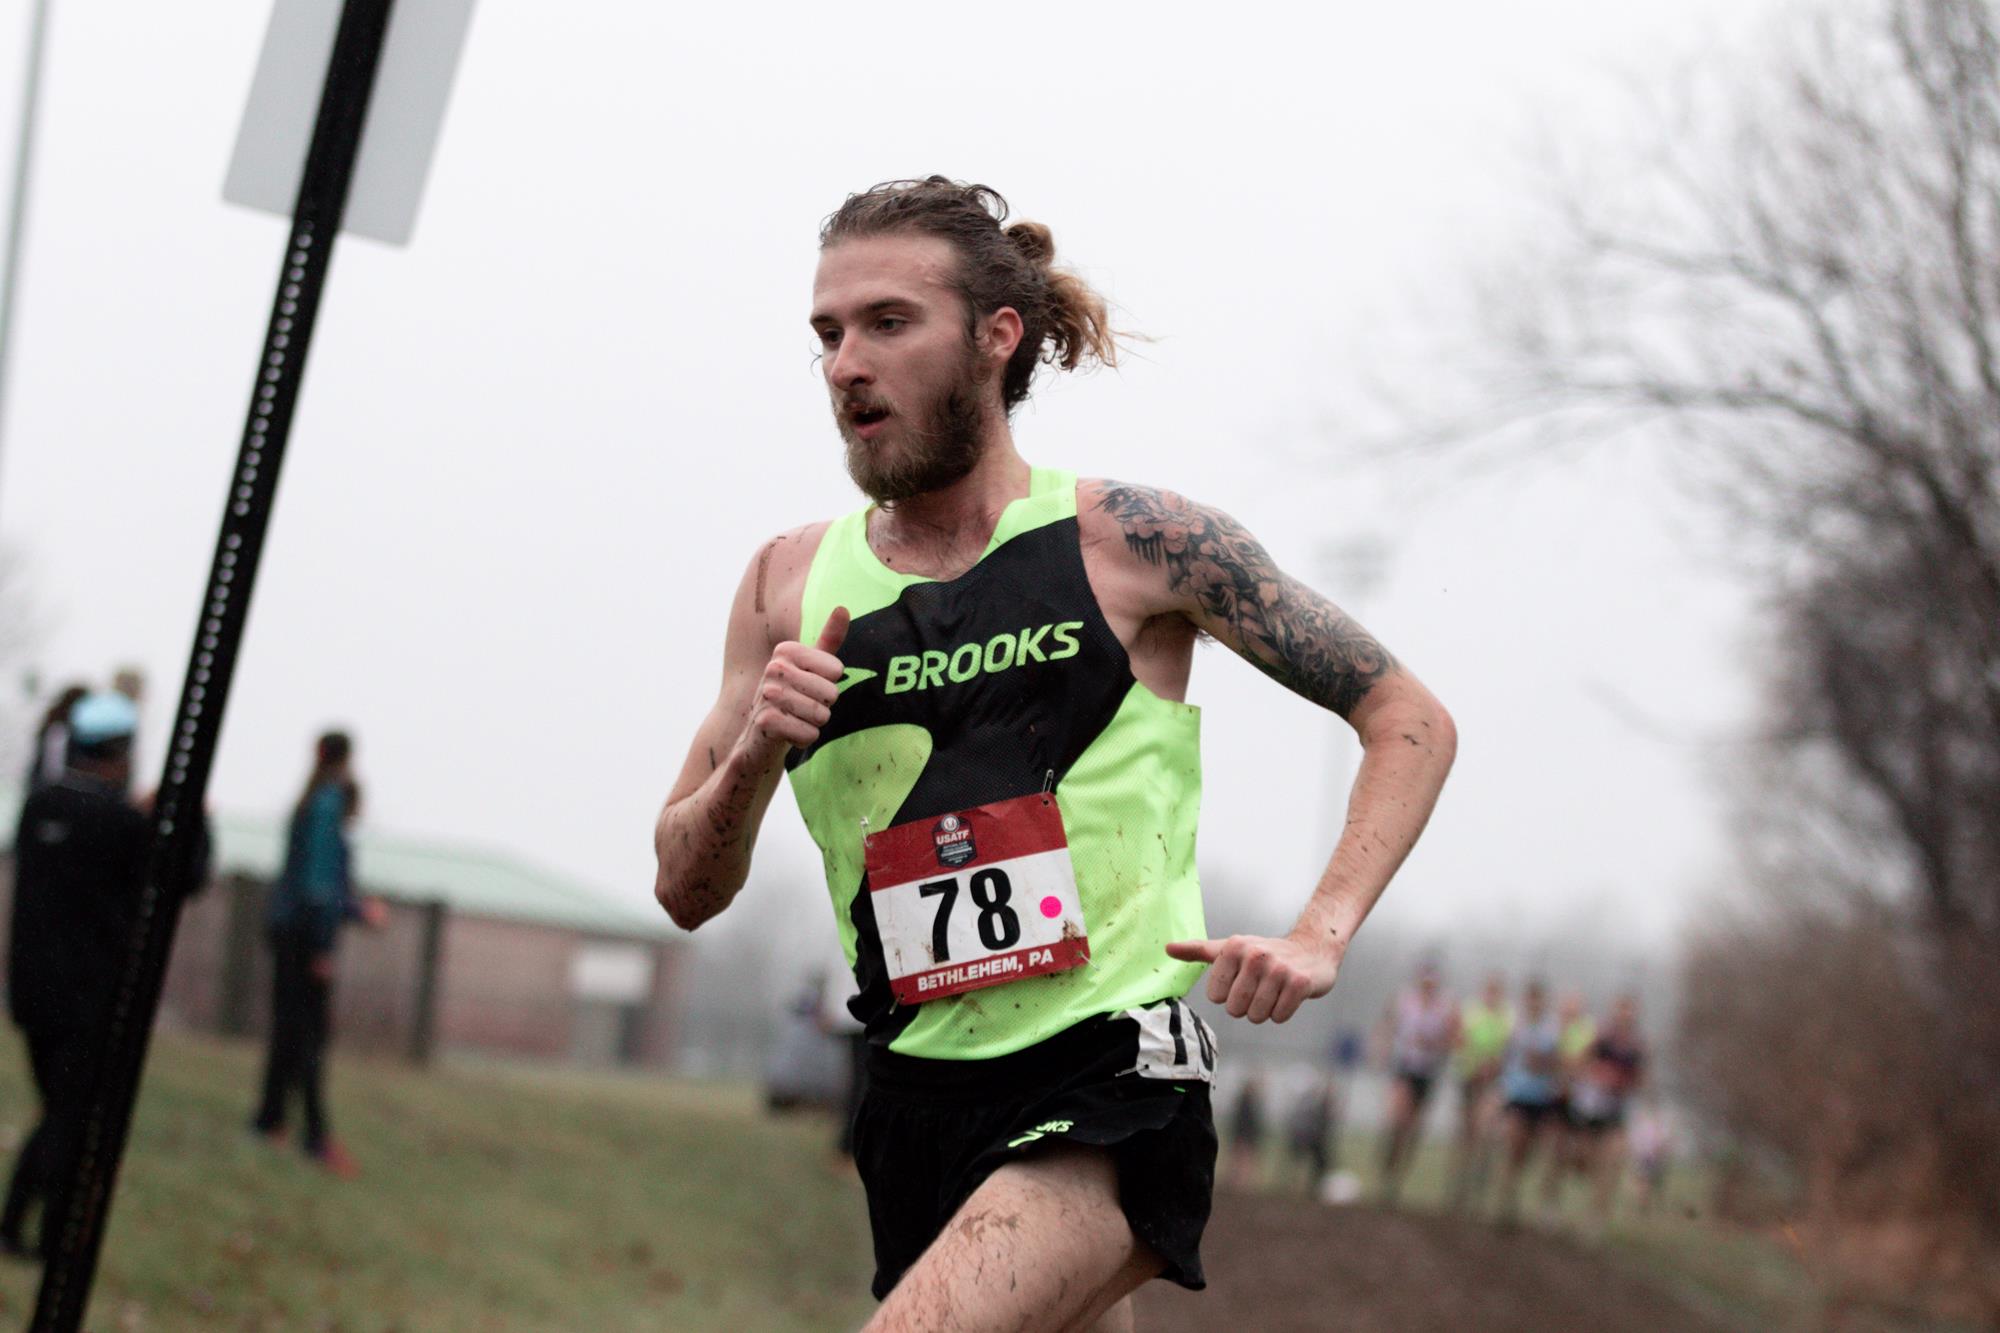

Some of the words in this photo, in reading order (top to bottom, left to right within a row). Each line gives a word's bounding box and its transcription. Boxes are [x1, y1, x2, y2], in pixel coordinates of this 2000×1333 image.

[885, 621, 1084, 694] BROOKS
[936, 829, 969, 845] USATF
[919, 868, 1020, 963] 78
[918, 956, 1023, 992] BETHLEHEM,
[1029, 949, 1054, 967] PA
